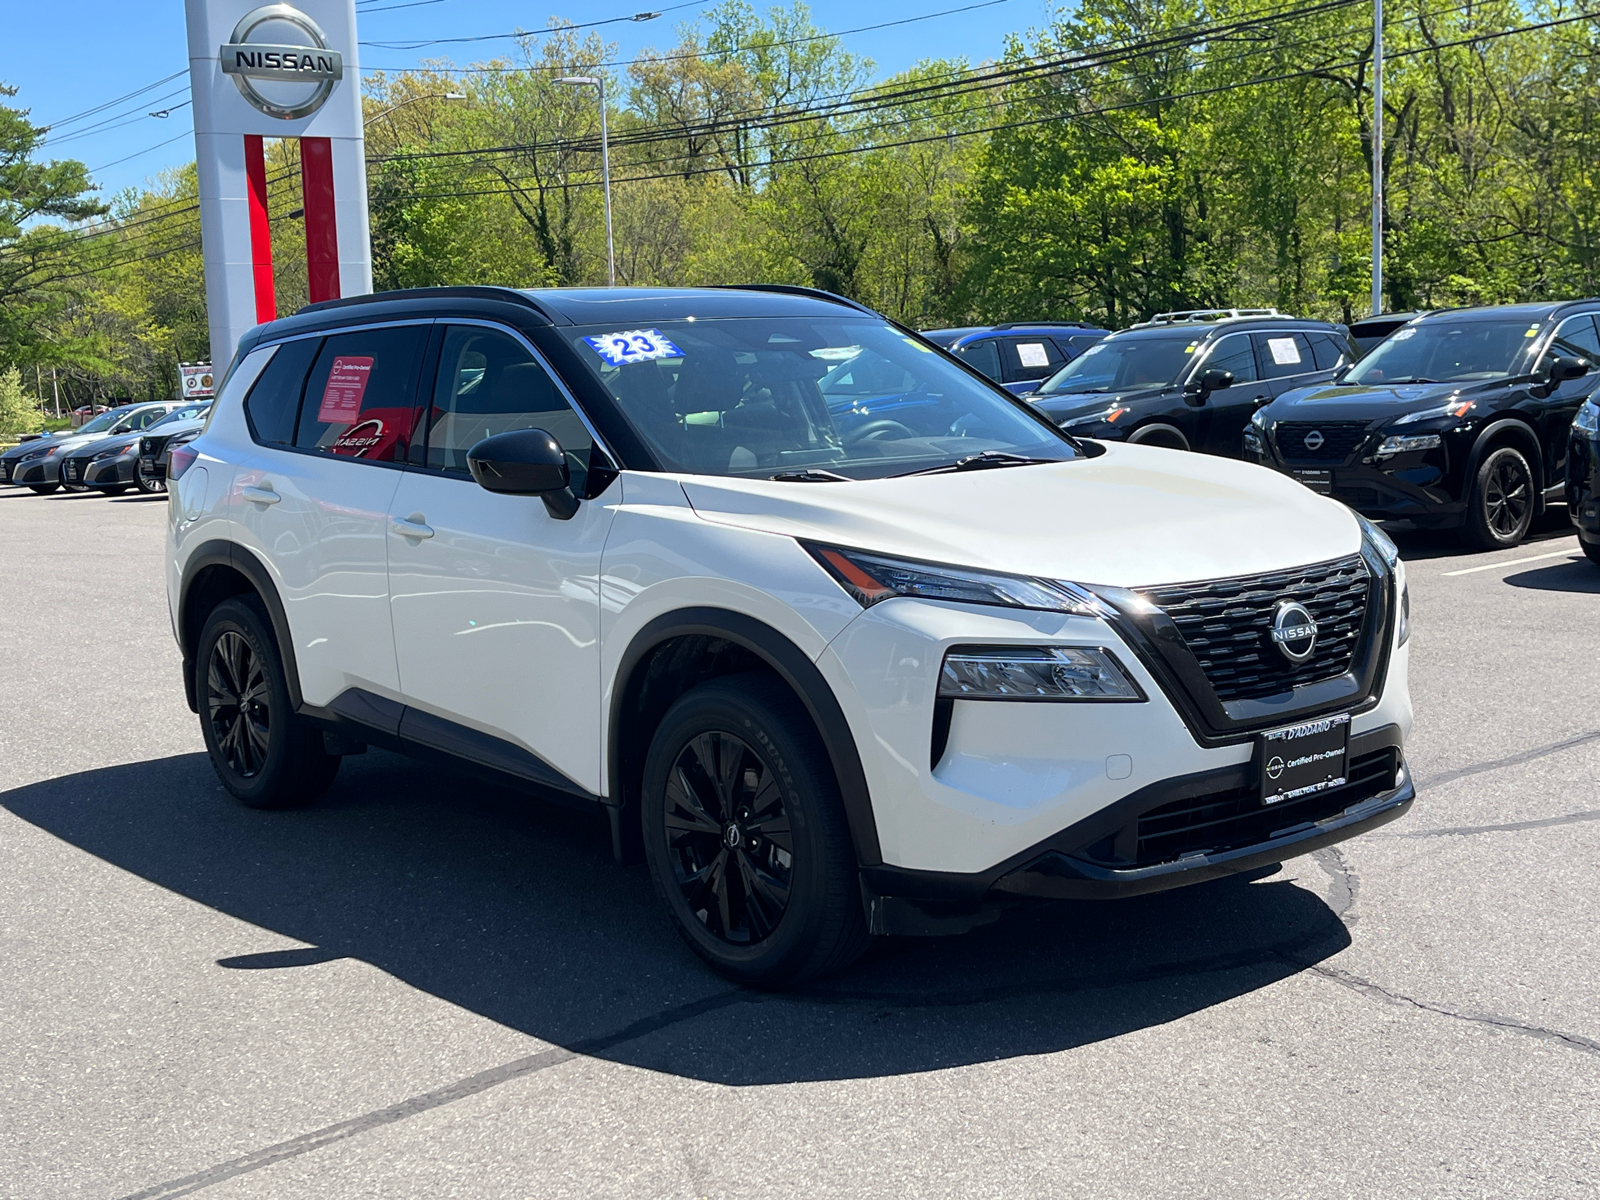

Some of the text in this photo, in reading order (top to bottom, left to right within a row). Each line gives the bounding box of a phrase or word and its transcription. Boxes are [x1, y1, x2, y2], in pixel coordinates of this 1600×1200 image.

[235, 51, 334, 73] NISSAN
[612, 335, 656, 356] 23
[1273, 624, 1318, 640] NISSAN
[1287, 721, 1331, 740] D'ADDARIO
[1286, 746, 1346, 768] Certified Pre-Owned
[754, 729, 806, 827] DUNLOP
